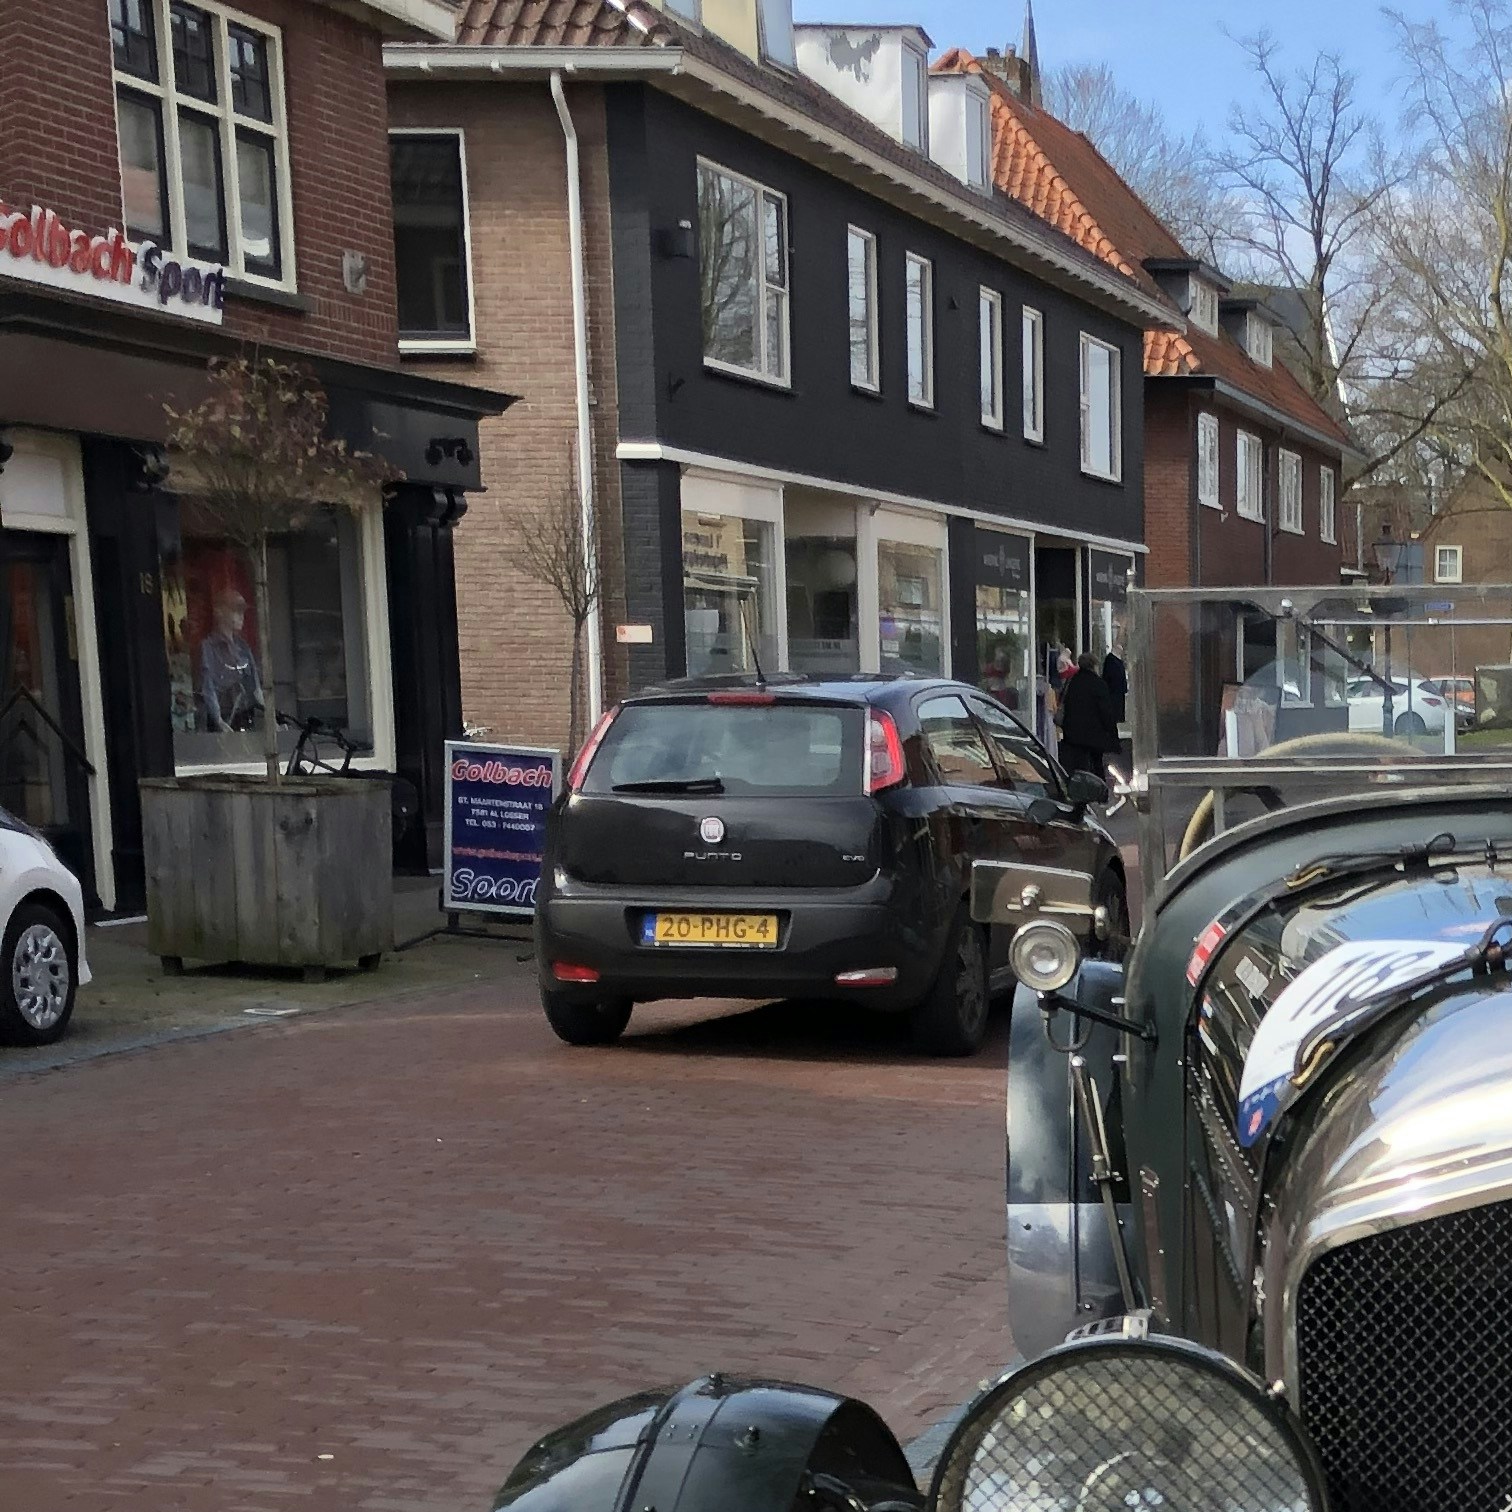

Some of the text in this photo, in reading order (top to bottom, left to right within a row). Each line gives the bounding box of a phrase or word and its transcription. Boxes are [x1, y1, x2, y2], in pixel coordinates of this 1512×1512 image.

[137, 240, 226, 309] Sport
[452, 759, 552, 788] Golbach
[683, 851, 742, 861] PUNTO
[662, 916, 770, 938] 20-PHG-4
